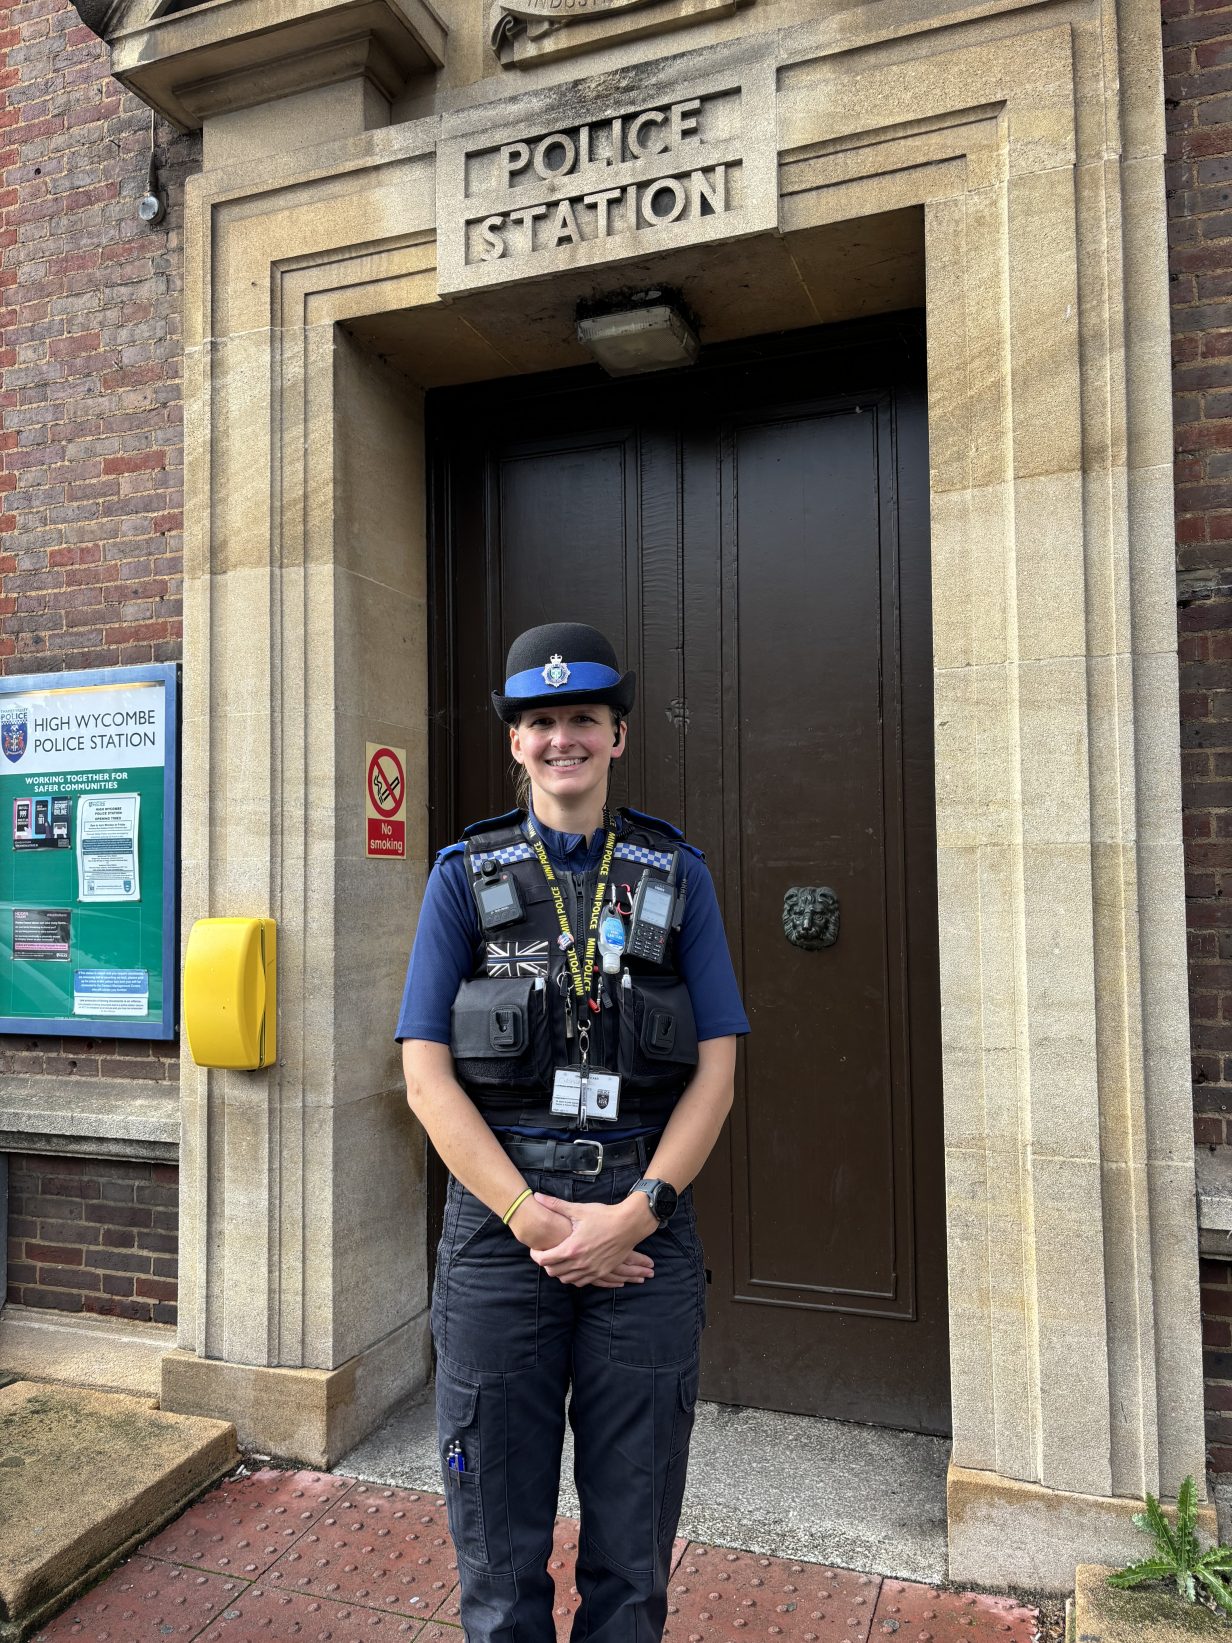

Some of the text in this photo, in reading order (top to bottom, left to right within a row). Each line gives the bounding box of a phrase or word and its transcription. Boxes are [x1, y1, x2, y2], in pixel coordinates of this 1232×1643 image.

[500, 100, 701, 189] POLICE
[481, 165, 726, 262] STATION
[1, 712, 28, 720] POLICE
[34, 710, 156, 733] HIGH WYCOMBE
[34, 732, 156, 753] POLICE STATION
[25, 772, 128, 785] WORKING TOGETHER FOR
[34, 782, 118, 793] SAFER COMMUNITIES
[381, 822, 392, 835] No
[605, 831, 616, 850] MINI
[370, 838, 403, 853] smoking
[533, 841, 555, 880] MINI POLICE
[600, 849, 613, 876] POLICE
[551, 886, 571, 934] MINI POLICE
[589, 882, 606, 930] MINI POLICE
[567, 946, 585, 996] MINI POLIC
[583, 937, 596, 992] MINI POLICE
